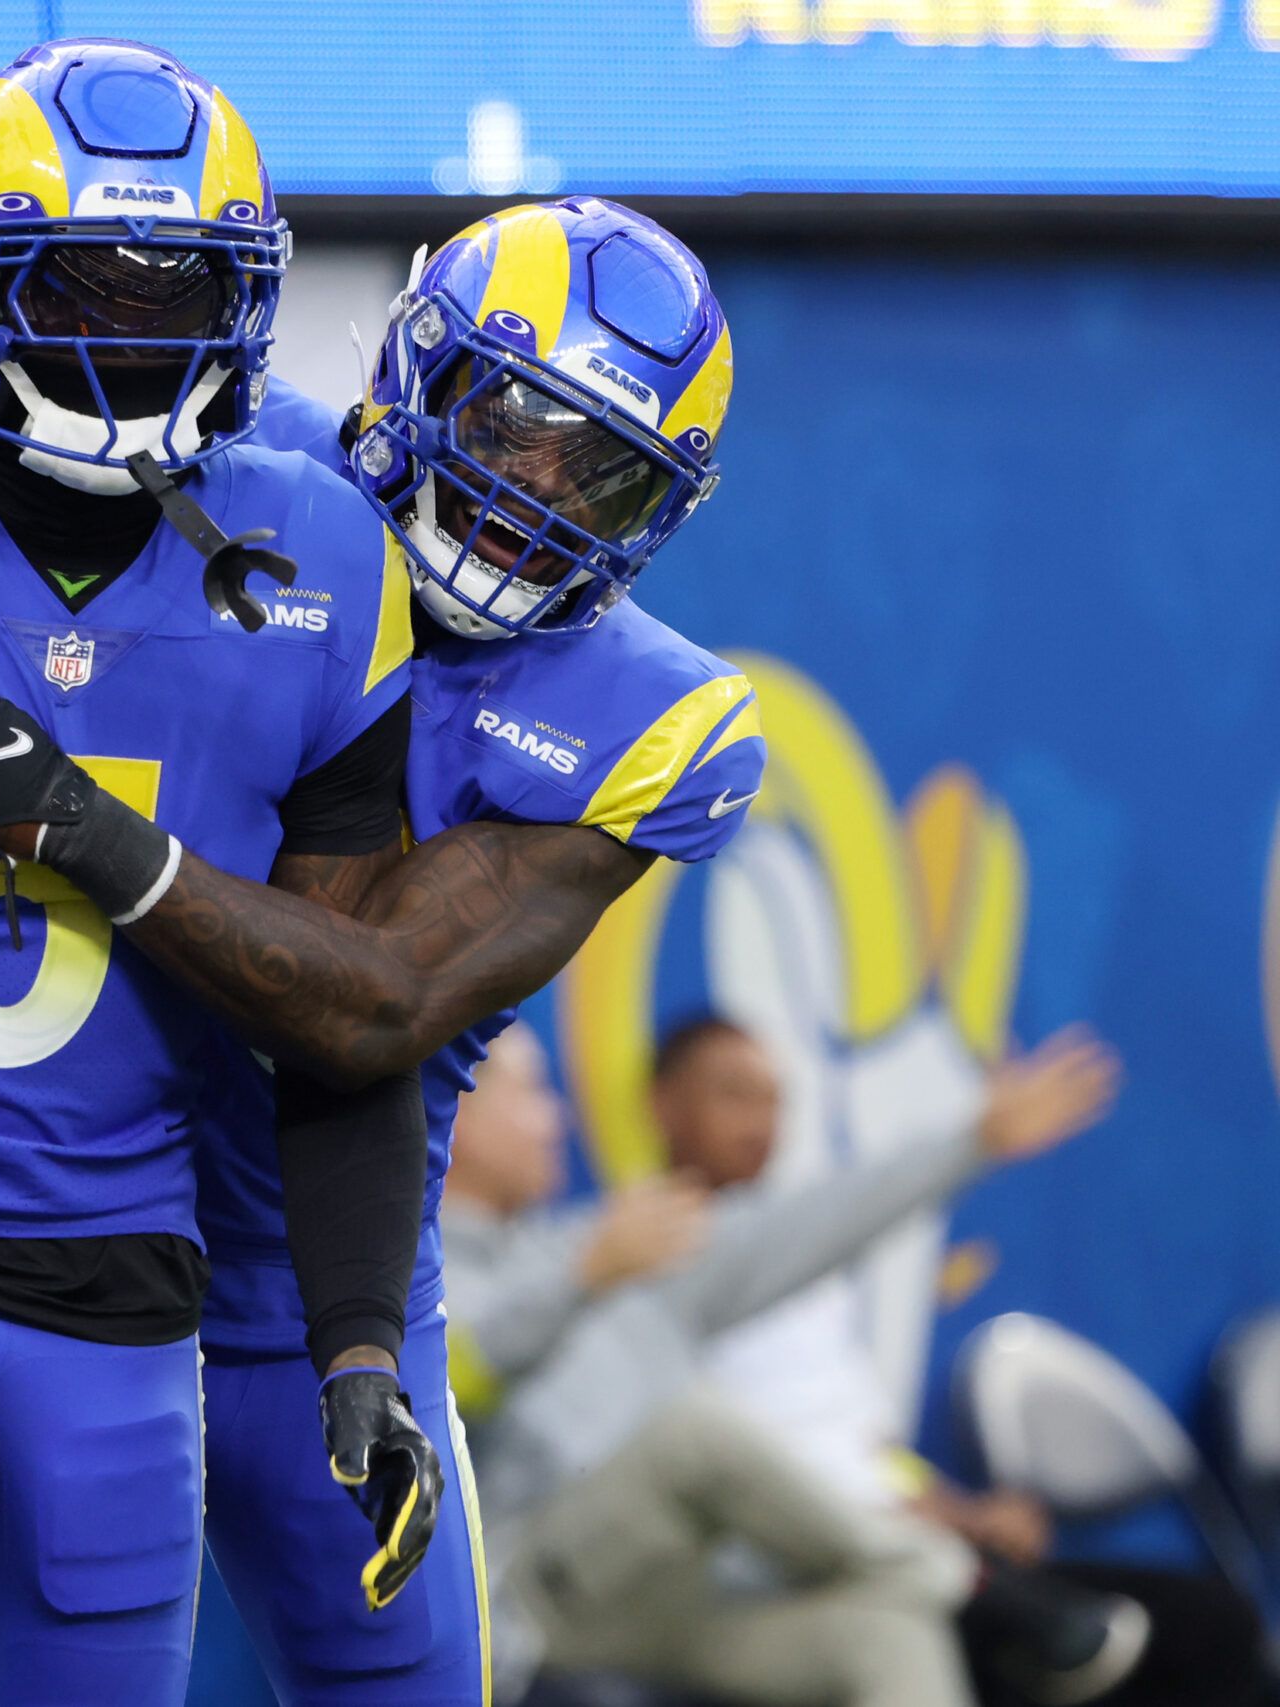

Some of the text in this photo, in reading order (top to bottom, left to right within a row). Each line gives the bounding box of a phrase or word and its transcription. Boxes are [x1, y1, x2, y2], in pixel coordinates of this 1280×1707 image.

[102, 186, 175, 205] RAMS
[586, 356, 652, 404] RAMS
[52, 657, 83, 681] NFL
[473, 709, 579, 775] RAMS
